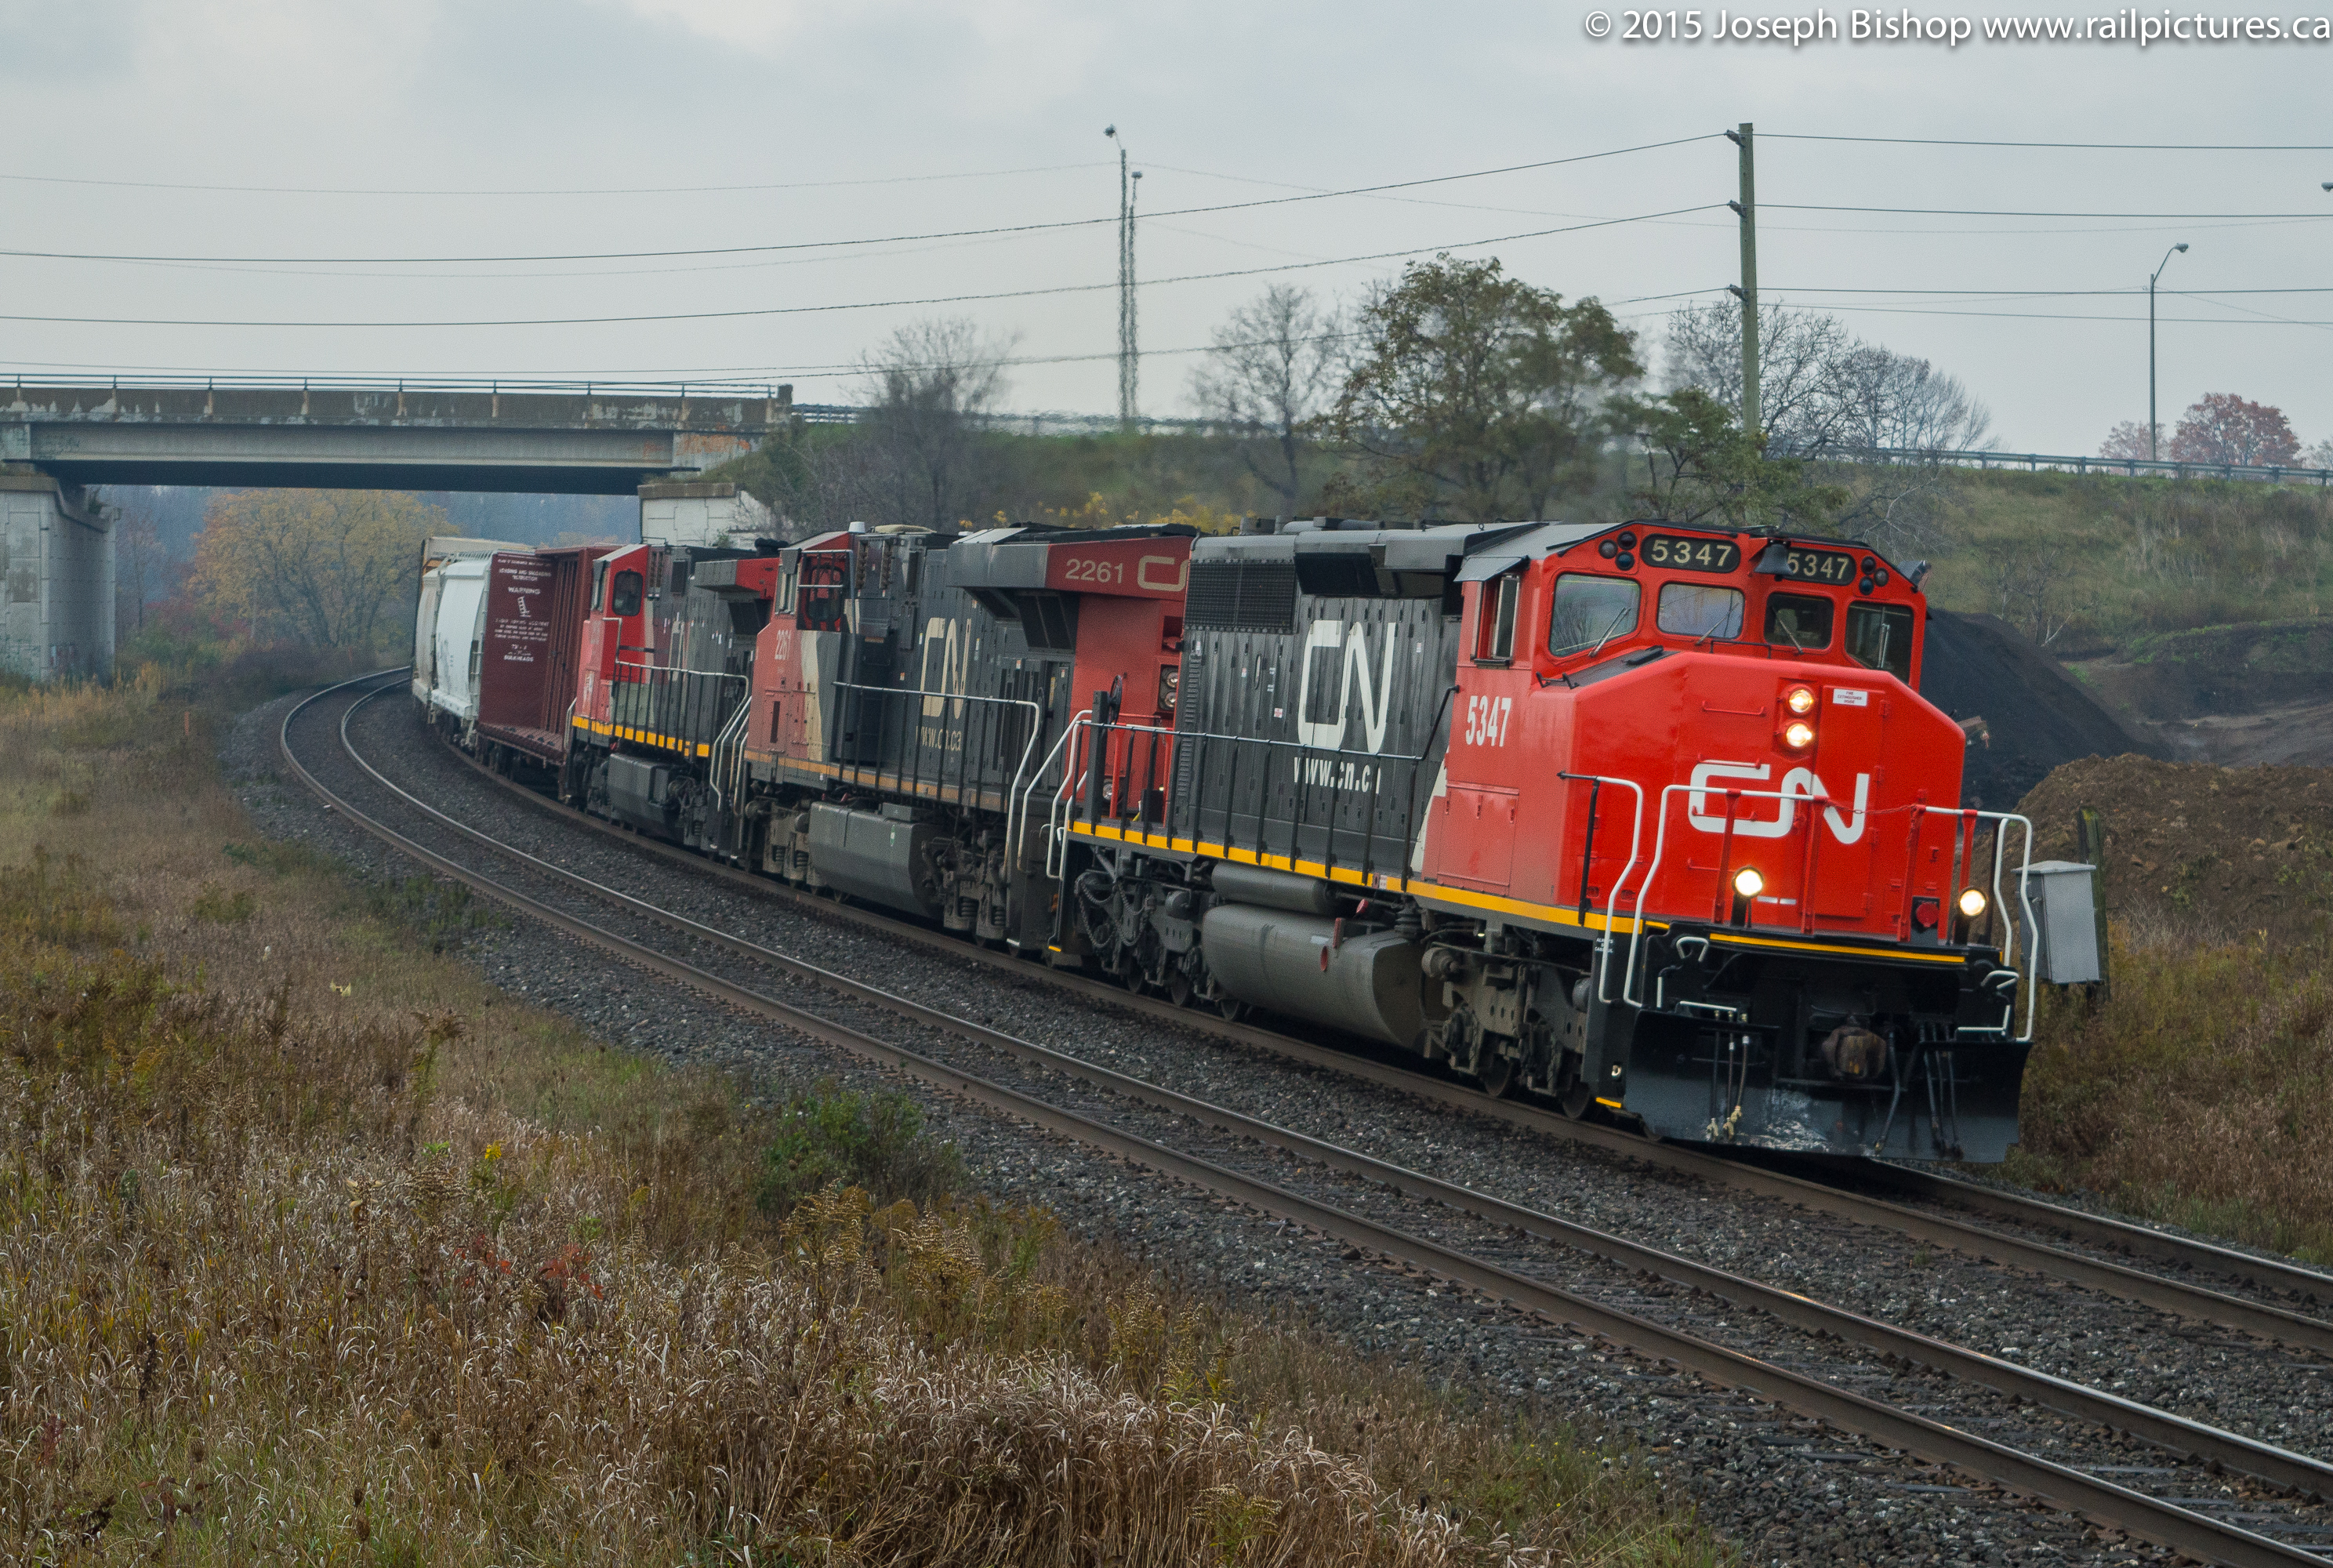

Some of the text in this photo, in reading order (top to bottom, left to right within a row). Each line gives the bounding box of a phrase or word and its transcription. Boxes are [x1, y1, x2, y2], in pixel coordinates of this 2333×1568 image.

[1065, 555, 1190, 592] 2261 C
[1651, 539, 1732, 567] 5347
[1787, 552, 1849, 579] 5347
[920, 617, 971, 719] CN
[1297, 619, 1396, 753] CN
[1465, 695, 1512, 747] 5347
[1688, 759, 1869, 844] CN
